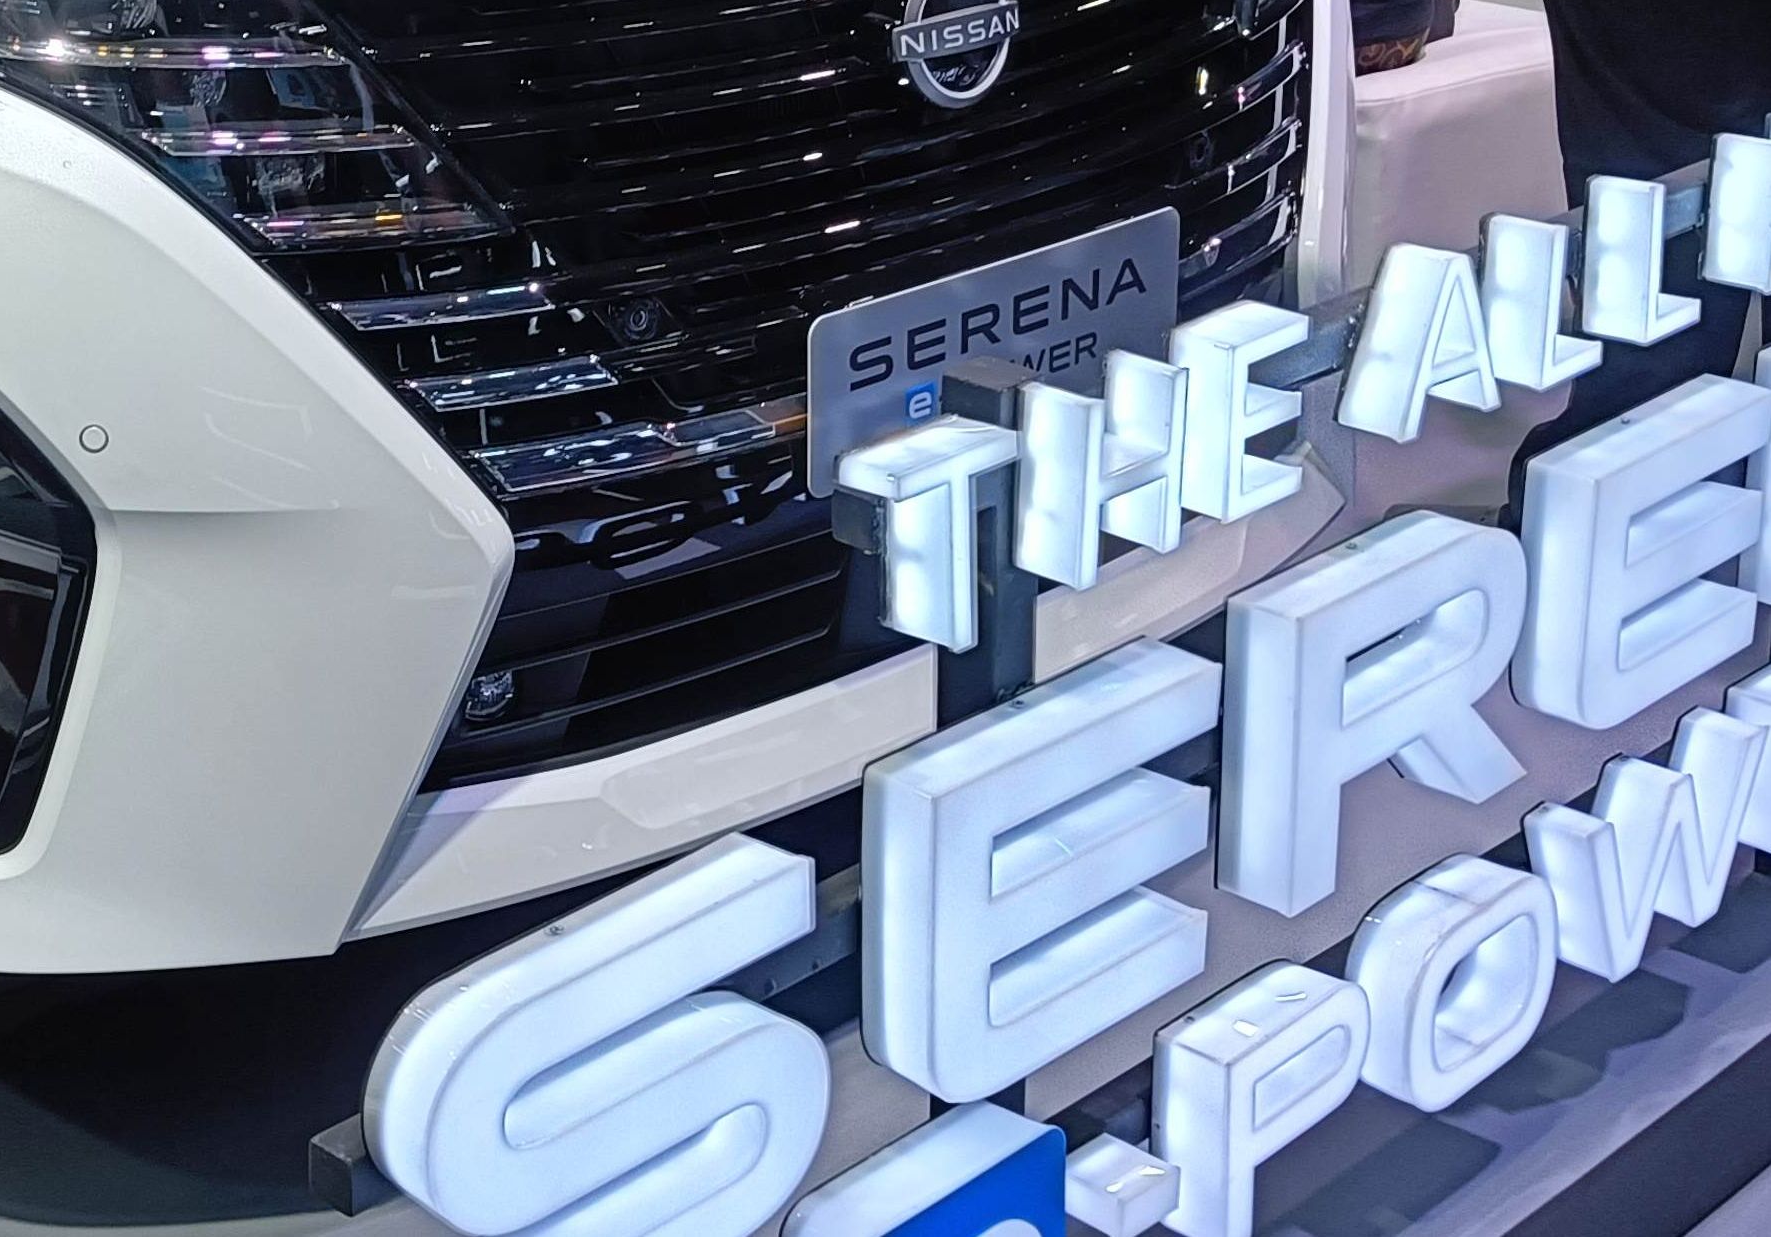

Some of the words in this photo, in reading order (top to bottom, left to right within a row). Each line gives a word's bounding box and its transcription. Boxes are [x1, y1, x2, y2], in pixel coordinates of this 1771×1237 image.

[899, 8, 1020, 57] NISSAN
[835, 298, 1310, 653] THE
[1336, 173, 1703, 443] ALL
[849, 257, 1148, 393] SERENA
[362, 372, 1771, 1237] SERE
[780, 665, 1771, 1237] -POW
